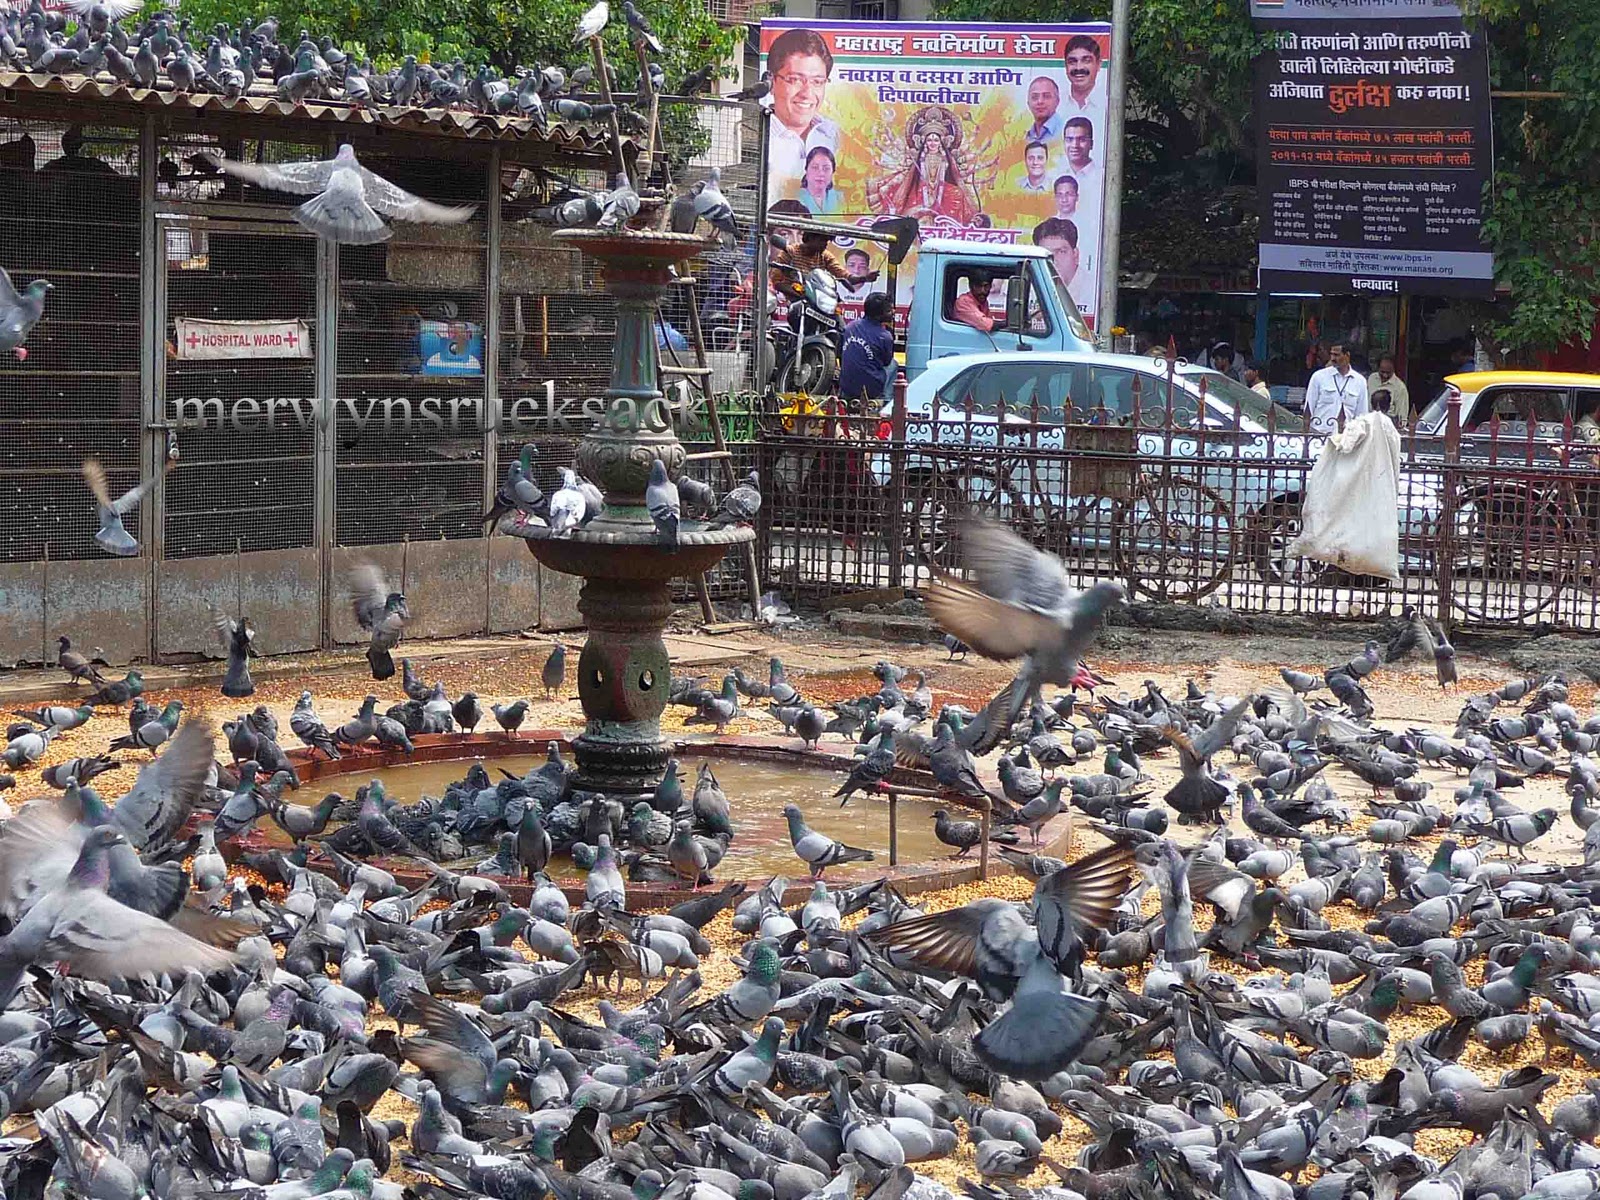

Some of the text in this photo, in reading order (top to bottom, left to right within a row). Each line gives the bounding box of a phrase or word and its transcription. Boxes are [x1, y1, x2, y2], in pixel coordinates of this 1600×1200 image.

[835, 33, 1056, 54] महाराष्ट्र नवनिर्माण सेना
[1300, 32, 1360, 50] तरुणांनो
[1363, 32, 1404, 50] आणि
[1406, 31, 1471, 49] तरुणींनो
[1279, 56, 1455, 75] खाली लिहिलेल्या गोष्टींकडे
[838, 69, 1023, 85] नवरात्र व दसरा आणि
[878, 86, 980, 104] दिपावलीच्या
[1269, 81, 1324, 99] अजिबात
[1328, 79, 1391, 113] दुर्लक्ष
[1288, 179, 1309, 188] IBPS
[202, 334, 282, 347] HOSPITAL WARD
